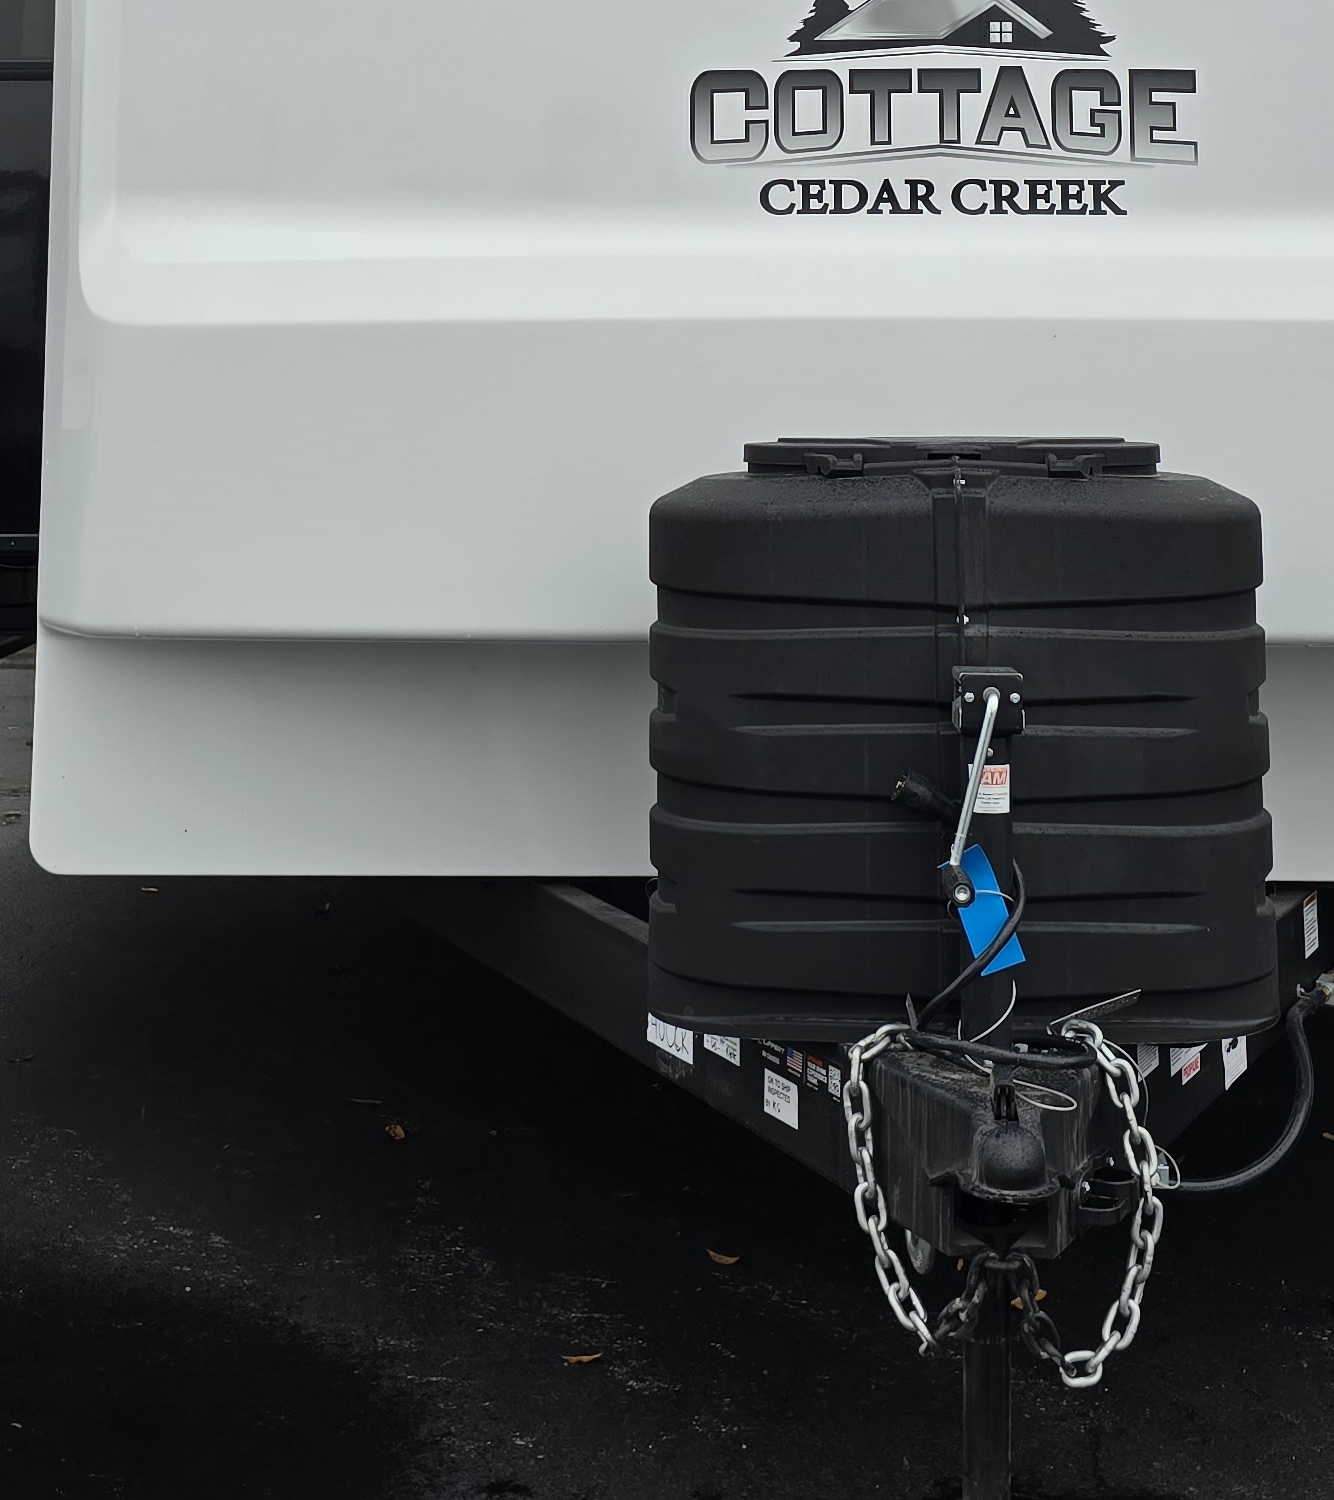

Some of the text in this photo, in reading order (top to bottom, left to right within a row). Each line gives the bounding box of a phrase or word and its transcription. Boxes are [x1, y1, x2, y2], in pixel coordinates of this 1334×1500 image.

[689, 66, 1199, 165] COTTAGE
[759, 178, 1128, 217] CEDAR CREEK
[981, 771, 1007, 785] AM
